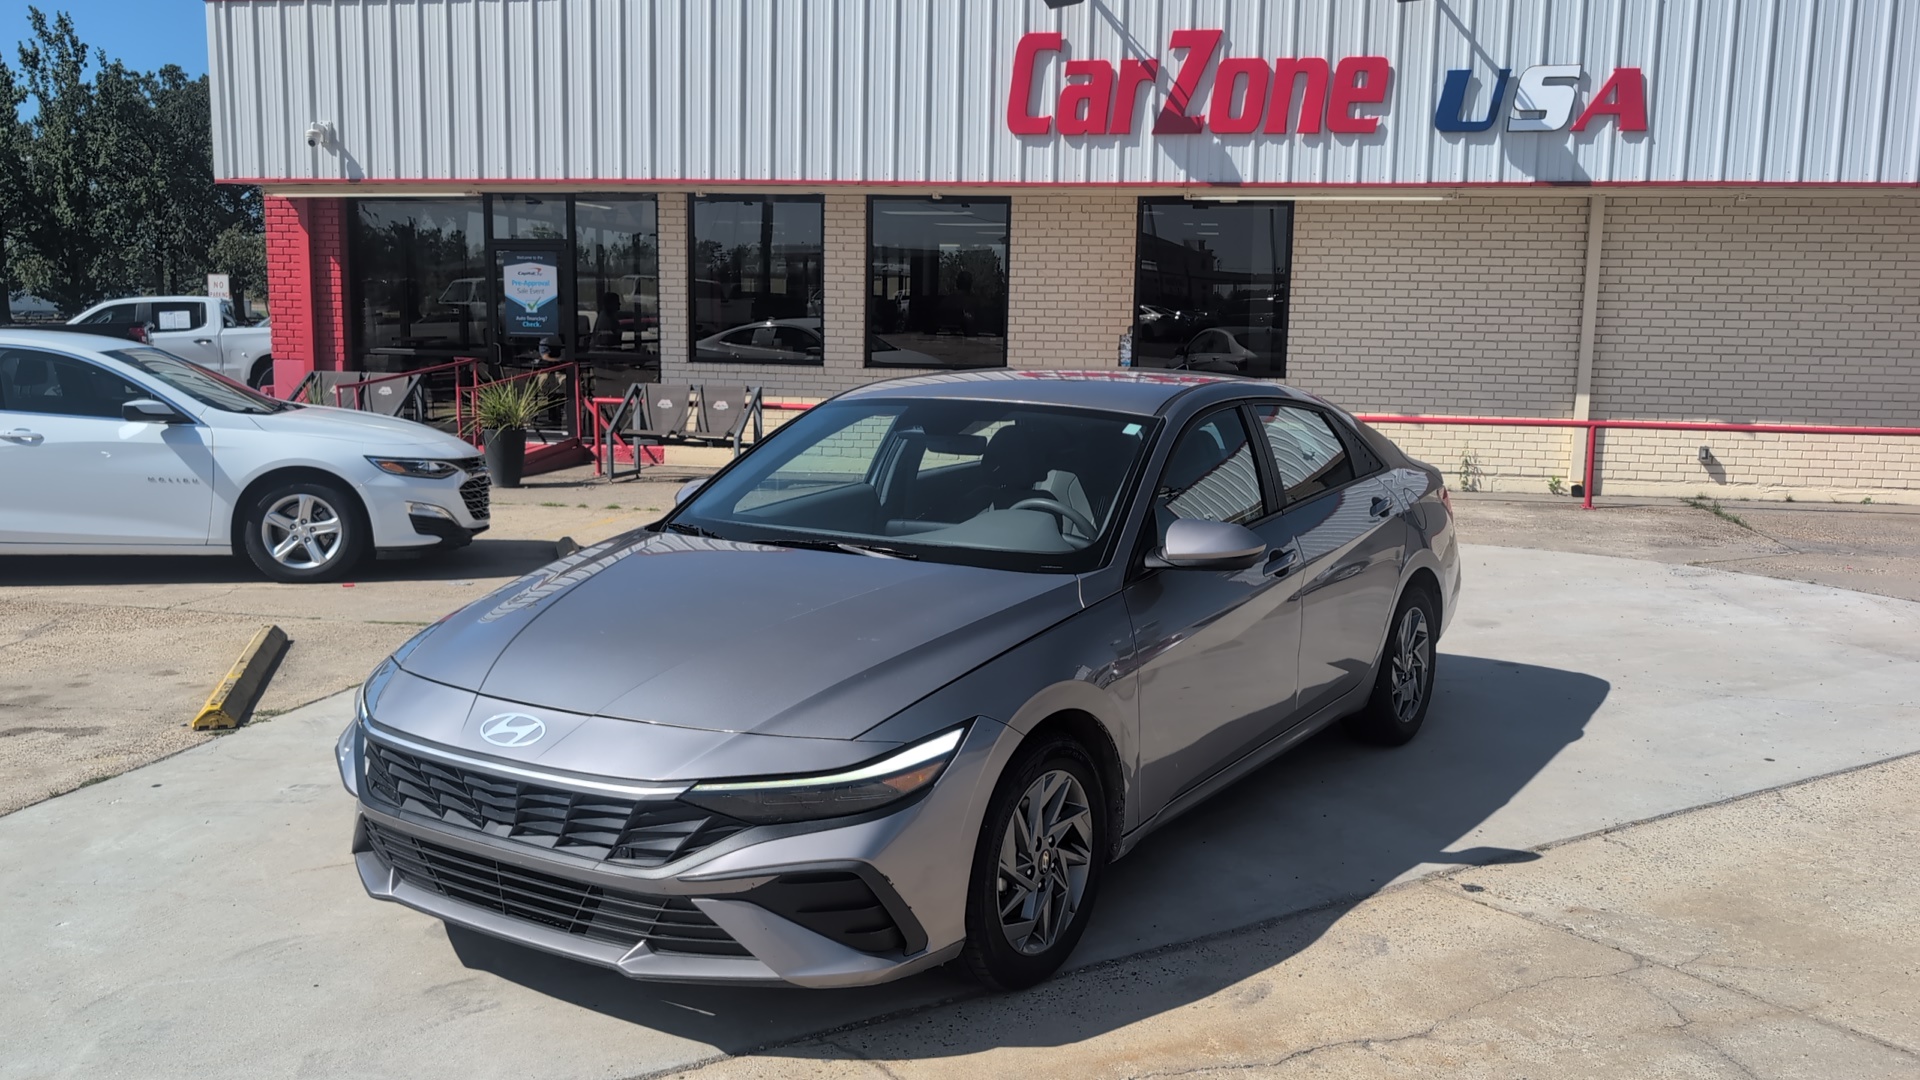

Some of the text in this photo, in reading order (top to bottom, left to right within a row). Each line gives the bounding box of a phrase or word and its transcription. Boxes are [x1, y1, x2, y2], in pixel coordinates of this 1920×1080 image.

[1007, 29, 1648, 136] CarZone USA
[213, 281, 224, 289] NO
